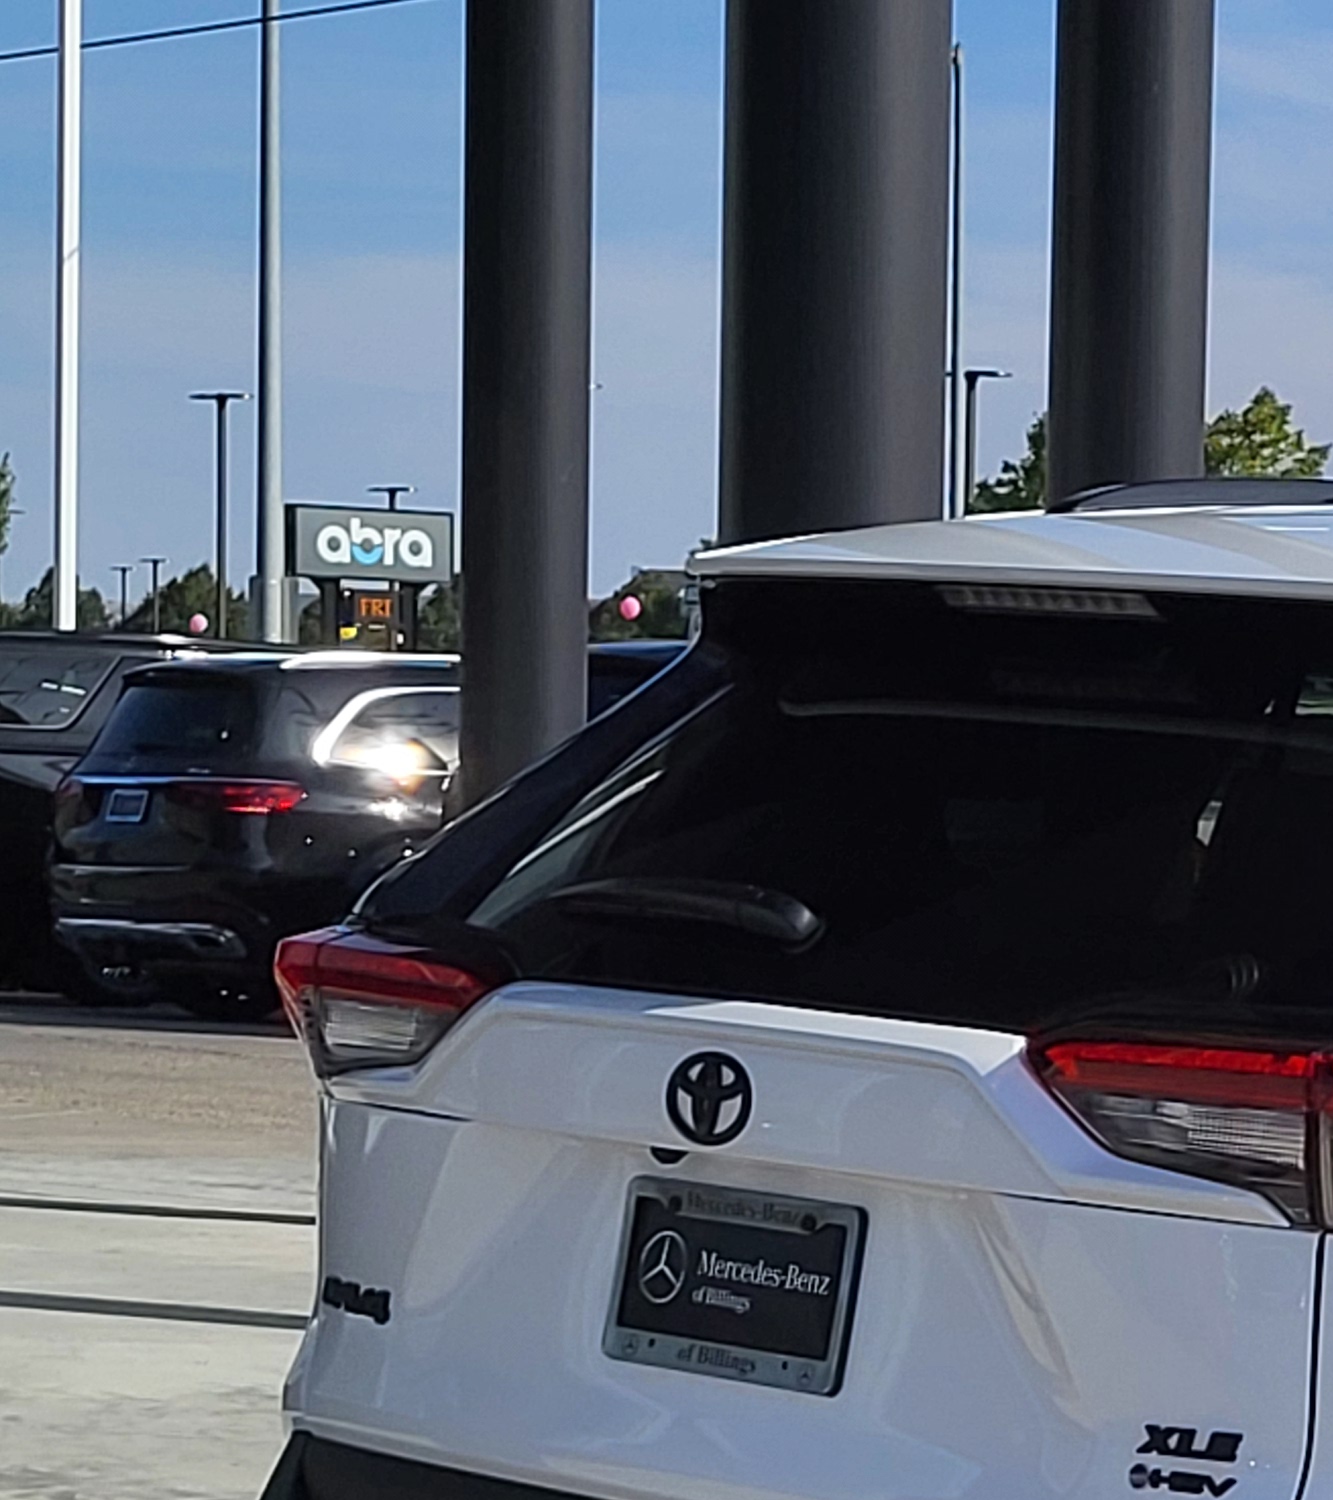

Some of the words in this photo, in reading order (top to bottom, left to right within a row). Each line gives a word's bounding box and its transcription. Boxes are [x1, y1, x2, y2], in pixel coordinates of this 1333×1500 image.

[317, 517, 433, 567] abra
[360, 598, 392, 617] FRI
[698, 1250, 831, 1295] Mercedes-Benz
[699, 1346, 756, 1375] Billings
